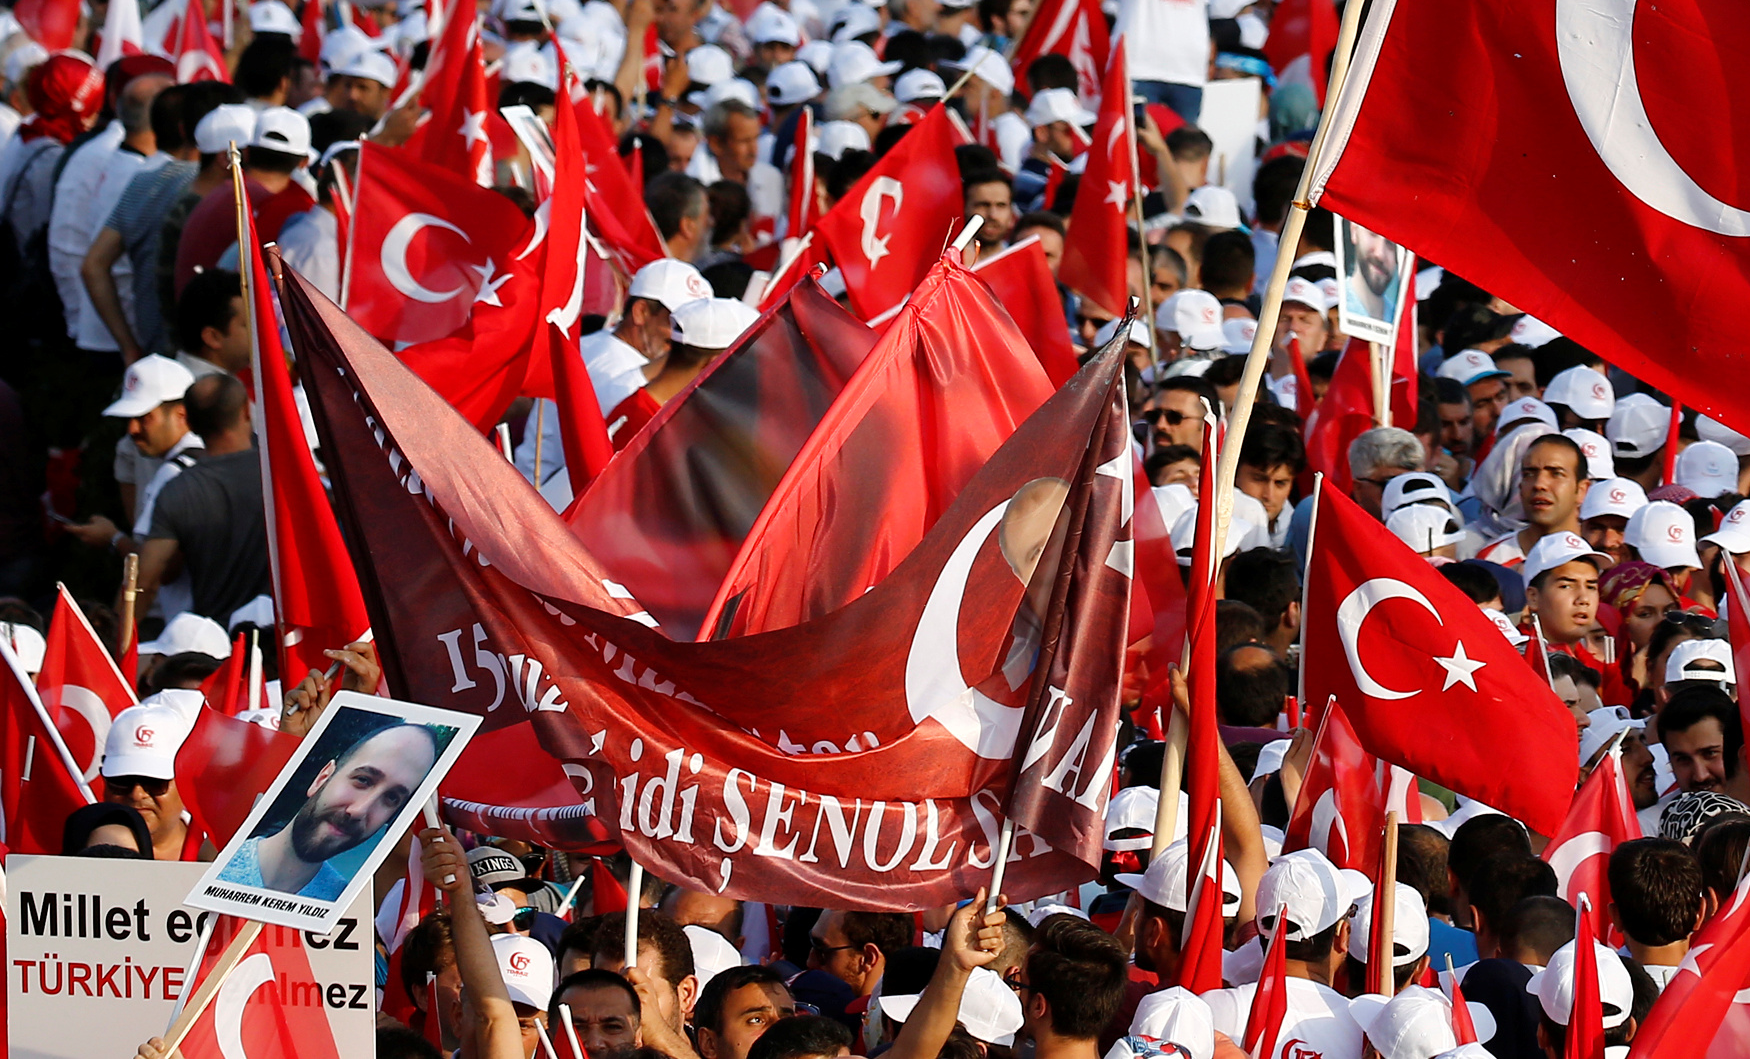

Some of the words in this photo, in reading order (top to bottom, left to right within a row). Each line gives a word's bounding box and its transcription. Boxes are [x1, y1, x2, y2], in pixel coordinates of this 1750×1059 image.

[713, 768, 957, 894] ŞENOL
[475, 856, 516, 876] KINGS
[20, 891, 151, 941] Millet
[203, 885, 262, 905] MUHARREM
[260, 897, 298, 913] KEREM
[297, 904, 330, 919] YILDIZ
[13, 952, 185, 1001] TÜRKİYE
